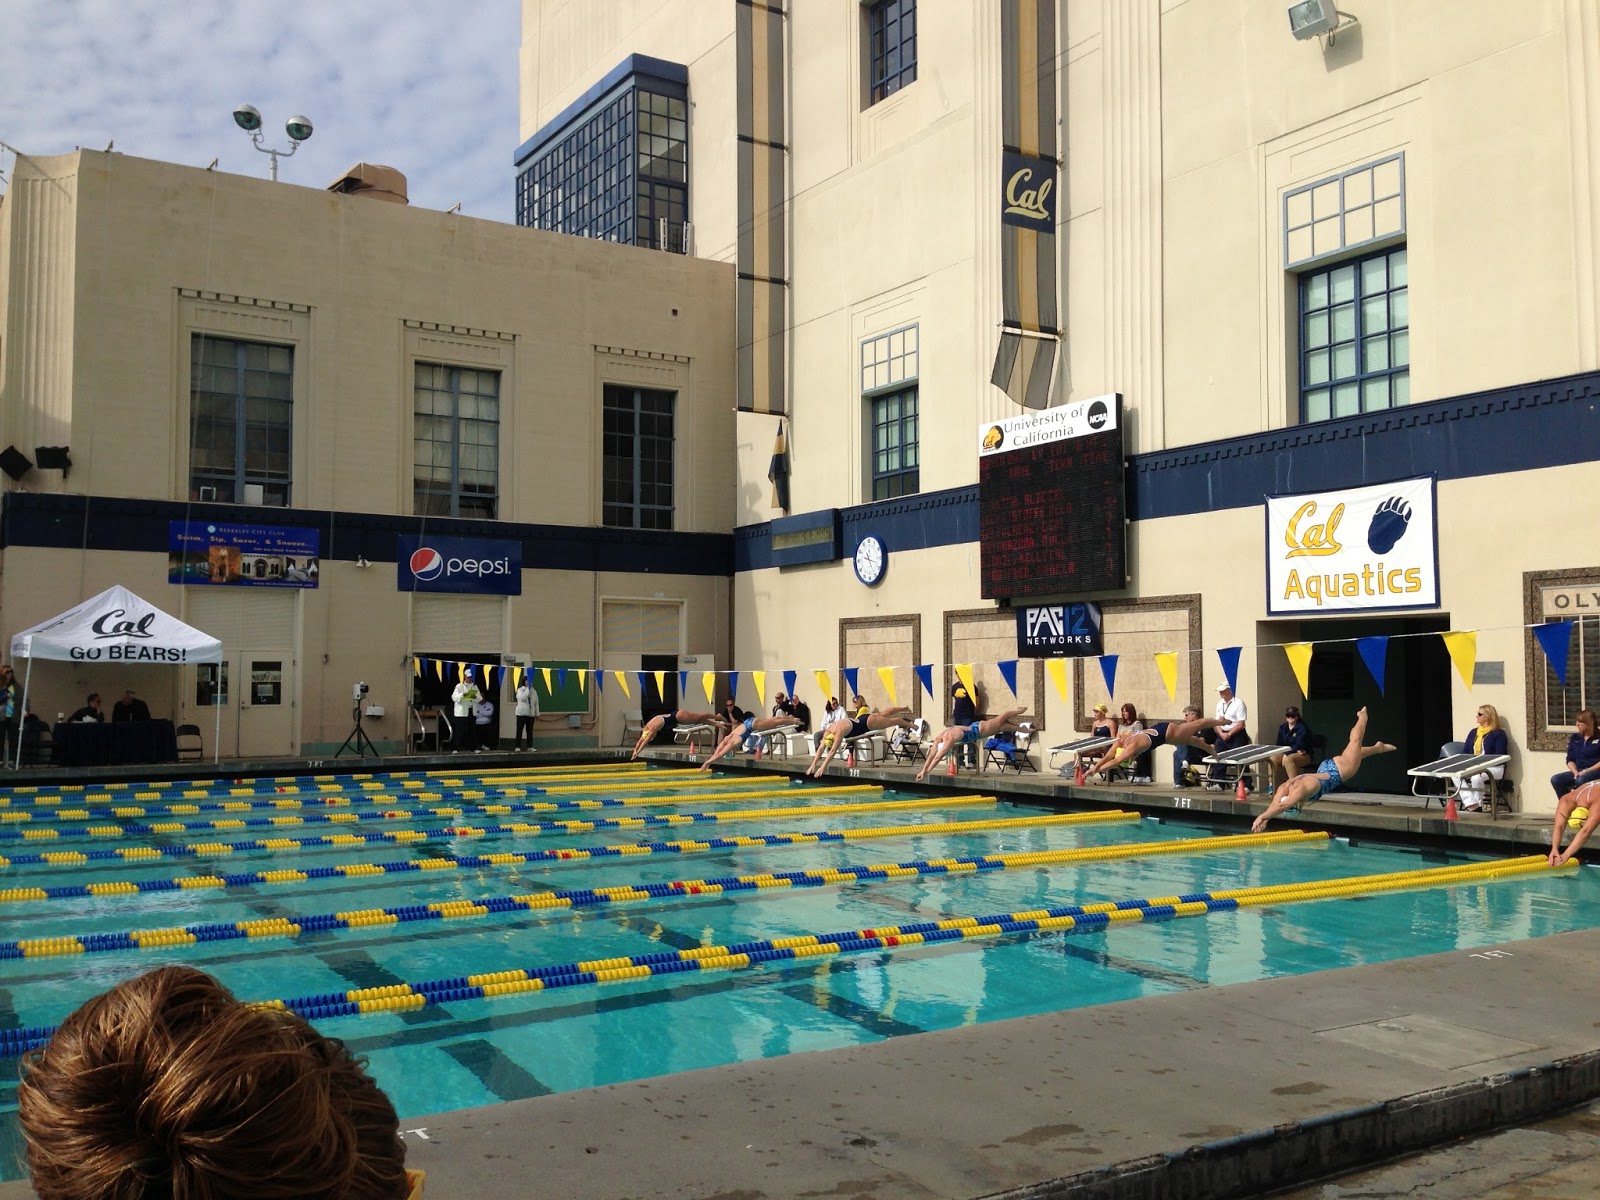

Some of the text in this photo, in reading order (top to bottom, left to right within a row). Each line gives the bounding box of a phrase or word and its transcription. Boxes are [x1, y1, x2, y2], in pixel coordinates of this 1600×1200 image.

[1004, 168, 1052, 219] Cal
[1003, 404, 1084, 433] University of
[1089, 412, 1108, 424] NCAA
[1013, 426, 1074, 447] California
[210, 535, 227, 543] Sip,
[232, 537, 260, 545] Savor,
[1285, 500, 1345, 560] Cal
[446, 557, 509, 578] pepsi
[1283, 562, 1422, 606] Aquatics
[92, 609, 156, 640] Cal
[1026, 635, 1092, 645] NETWORKS
[69, 645, 187, 662] GO BEARS!
[1174, 797, 1191, 808] 7 FT
